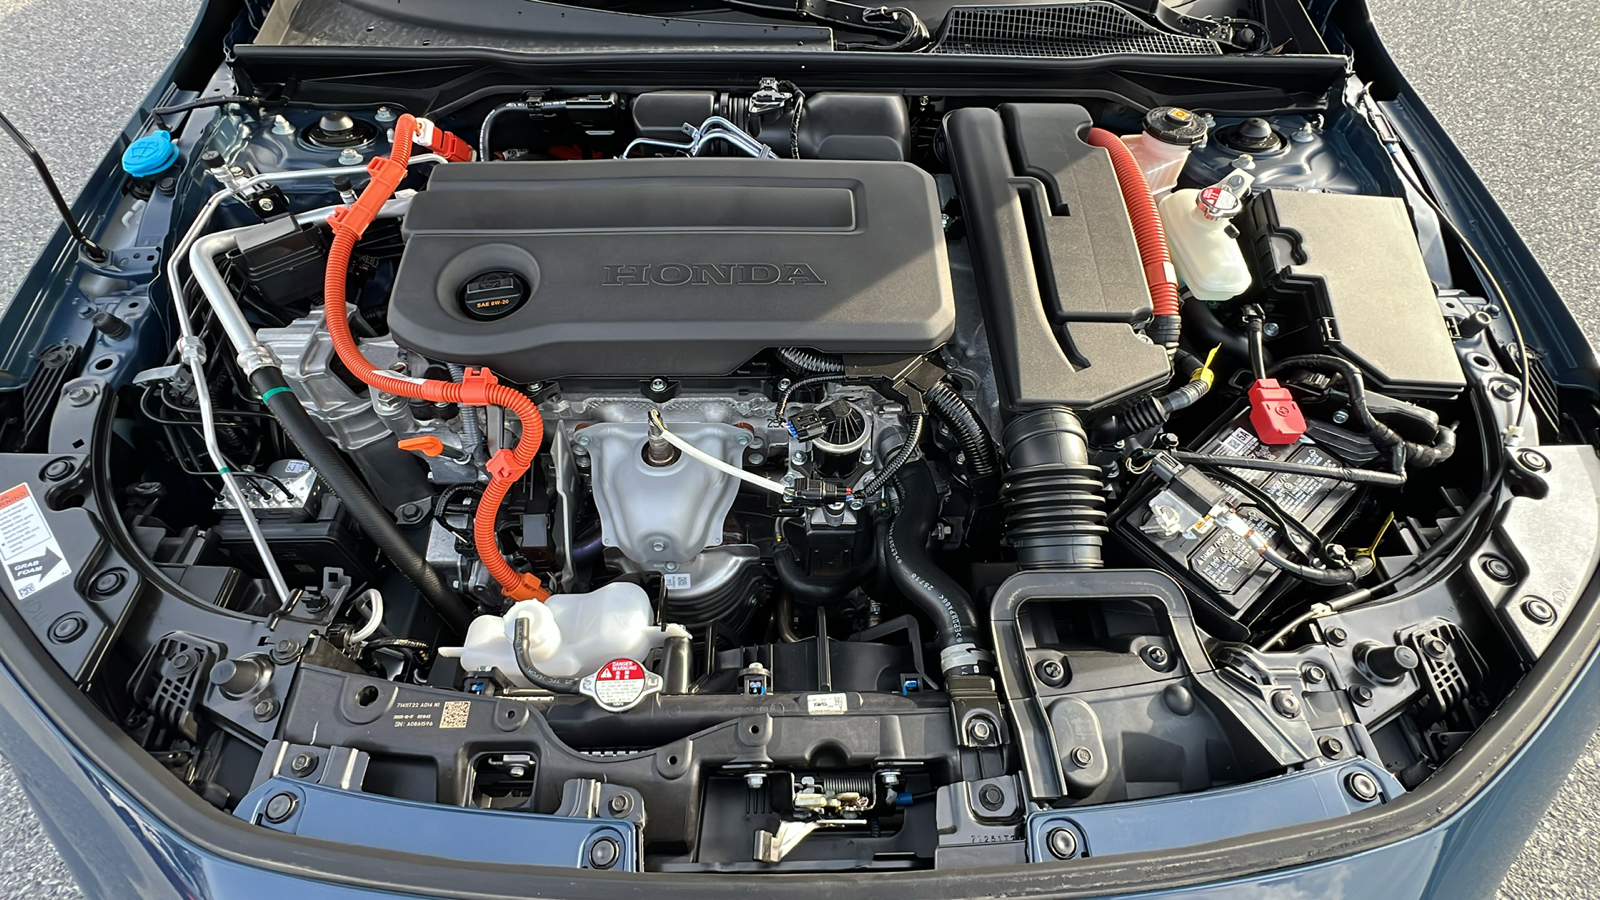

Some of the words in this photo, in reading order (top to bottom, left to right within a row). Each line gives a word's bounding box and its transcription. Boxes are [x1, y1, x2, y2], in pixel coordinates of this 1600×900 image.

[601, 262, 827, 286] HONDA
[490, 298, 510, 307] 0W-20
[1236, 430, 1250, 442] 5A
[13, 559, 40, 571] GRAB
[17, 565, 43, 577] FOAM
[910, 572, 934, 591] 25718
